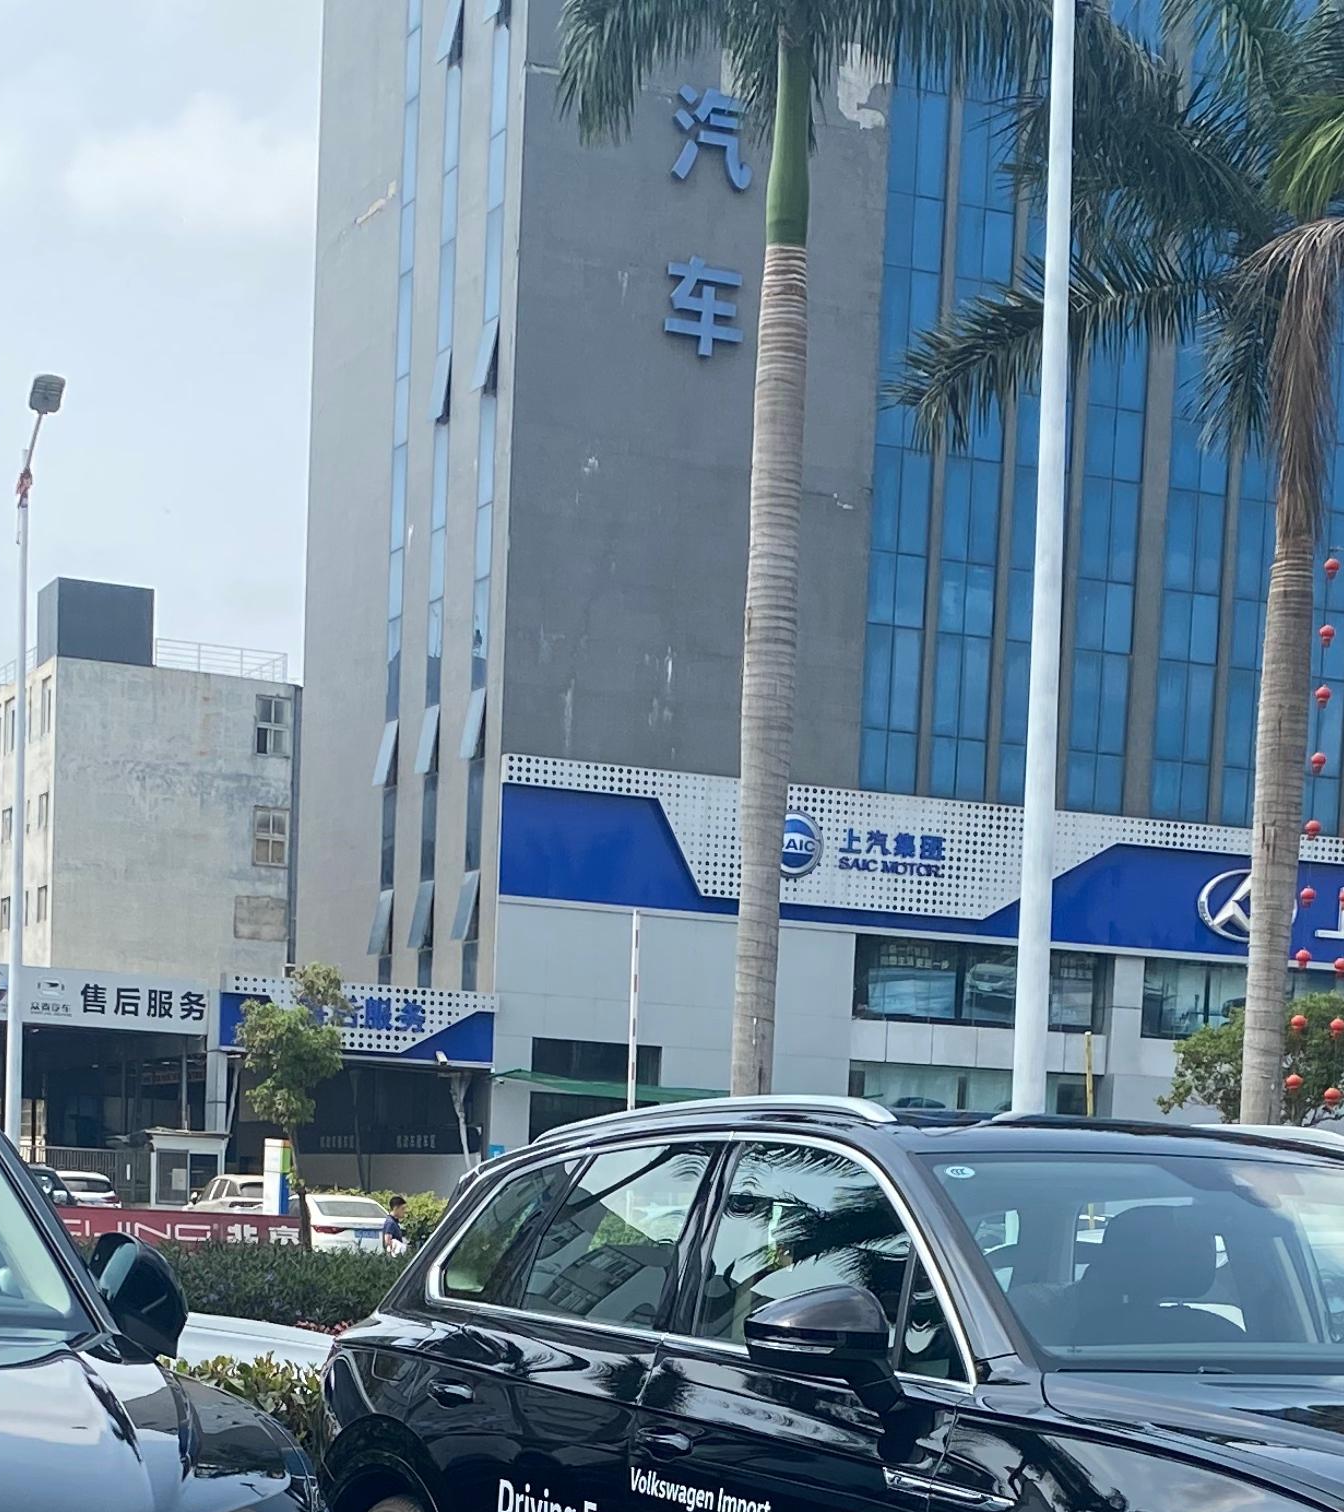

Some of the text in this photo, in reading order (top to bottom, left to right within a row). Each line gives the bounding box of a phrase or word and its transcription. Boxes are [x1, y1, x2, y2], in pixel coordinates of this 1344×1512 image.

[782, 837, 816, 852] AIC
[839, 827, 946, 861] 上汽集团
[838, 856, 944, 878] SAIC MOTOR
[80, 983, 207, 1021] 售后服务
[227, 1224, 300, 1244] 北京
[630, 1466, 714, 1510] Volkswagen
